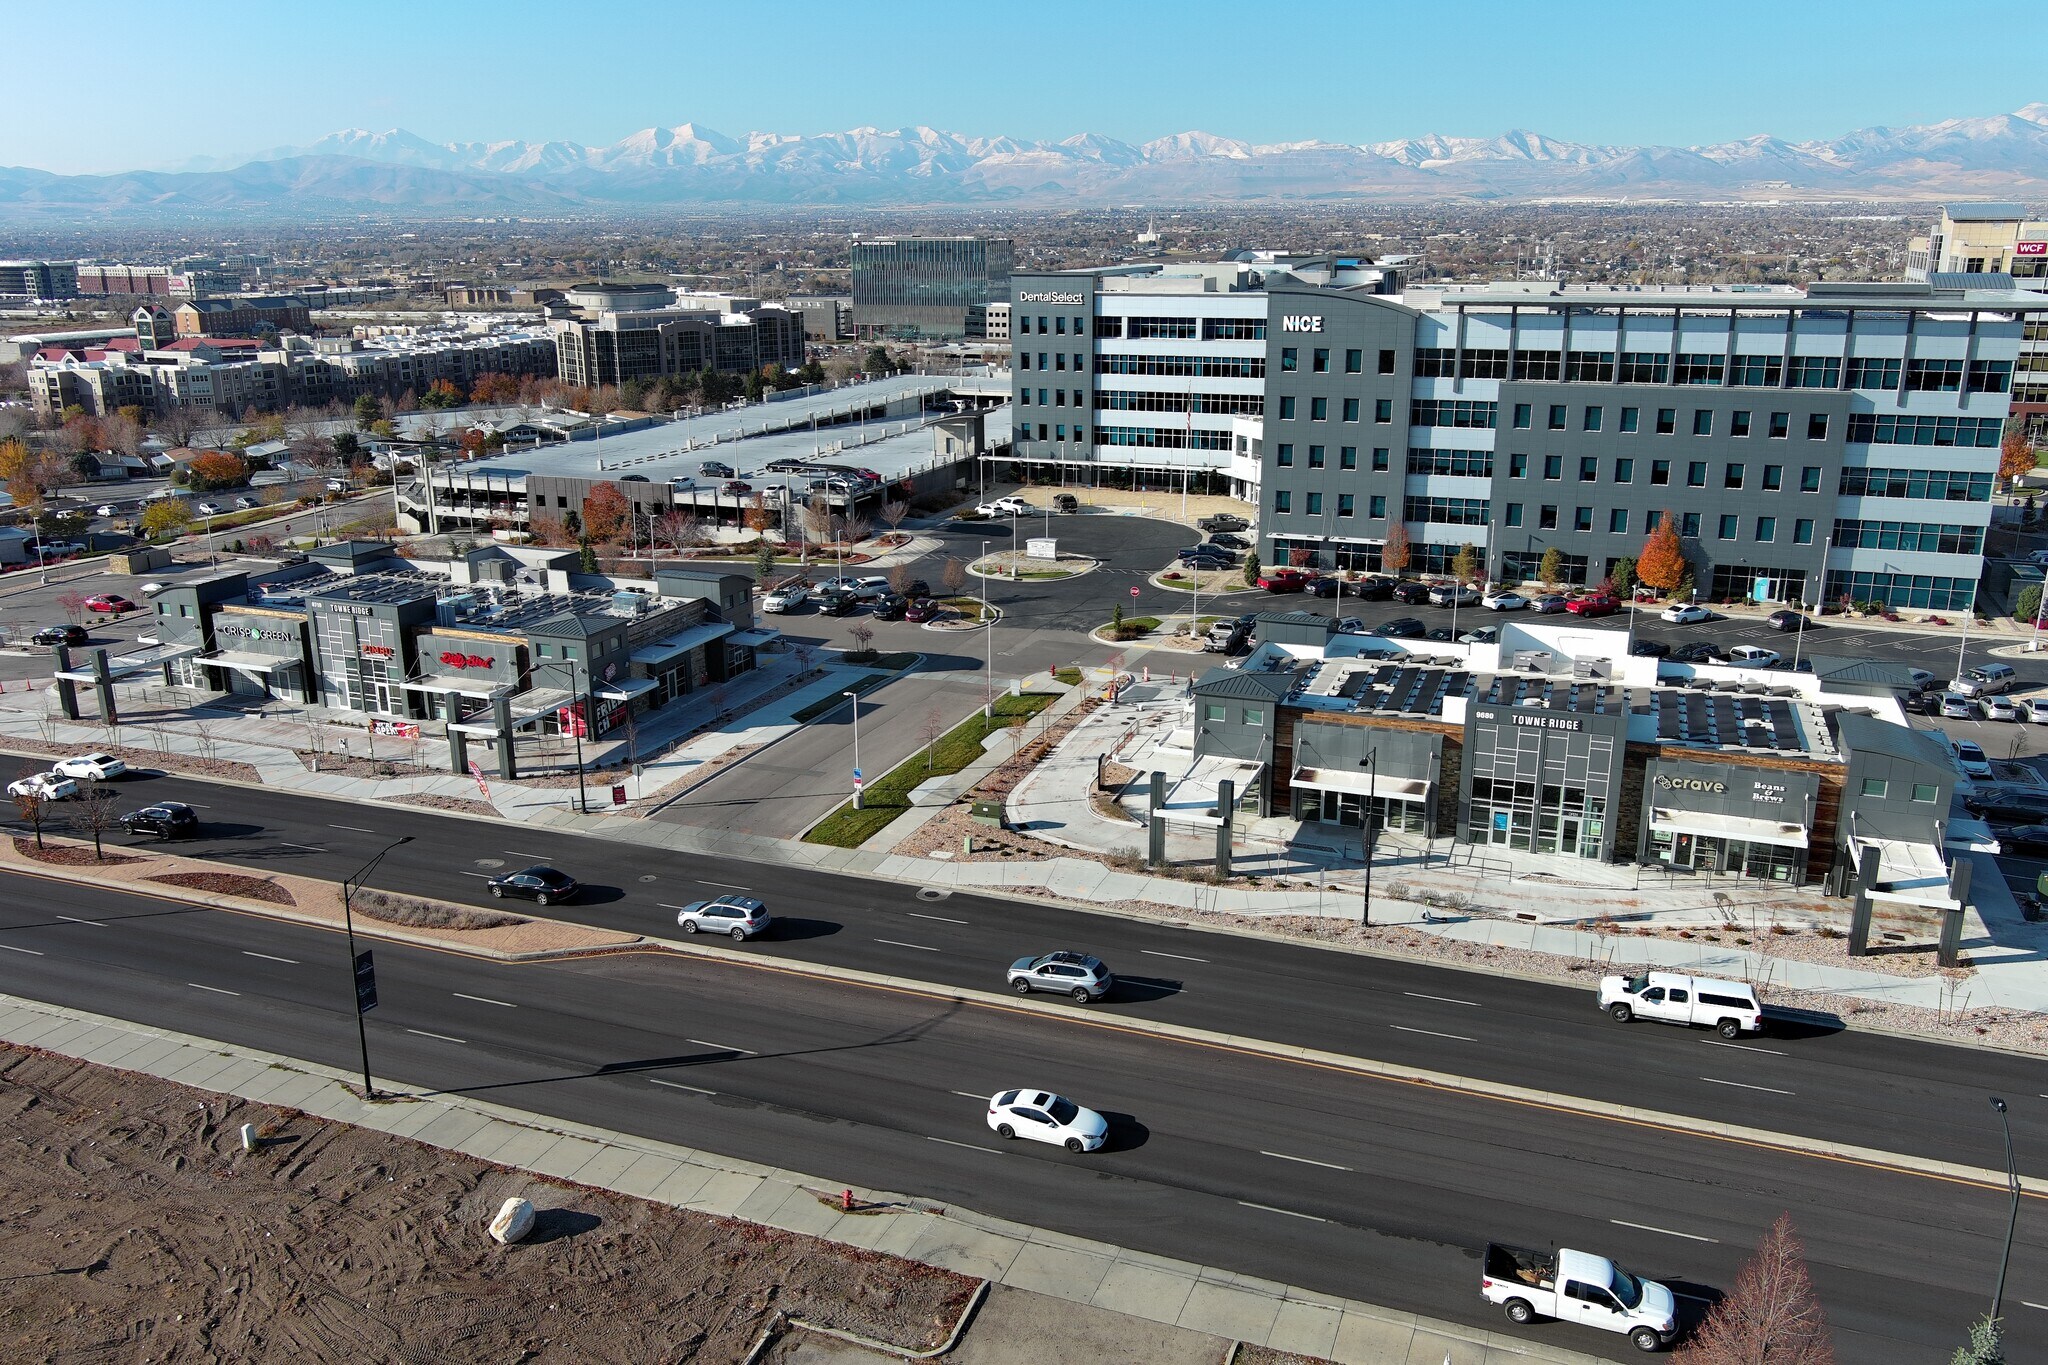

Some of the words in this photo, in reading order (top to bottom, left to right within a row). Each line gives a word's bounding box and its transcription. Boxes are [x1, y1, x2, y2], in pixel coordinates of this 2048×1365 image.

[2020, 244, 2044, 252] WCF
[1020, 291, 1084, 303] DentalSelect
[1282, 315, 1322, 332] NICE
[330, 604, 351, 613] TOWNE
[223, 625, 252, 638] CRISP
[259, 630, 290, 642] GREEN
[1512, 714, 1547, 727] TOWNE
[1548, 718, 1579, 731] RIDGE
[1672, 777, 1724, 793] crave
[1753, 781, 1786, 792] Beans
[1752, 792, 1784, 802] Brews
